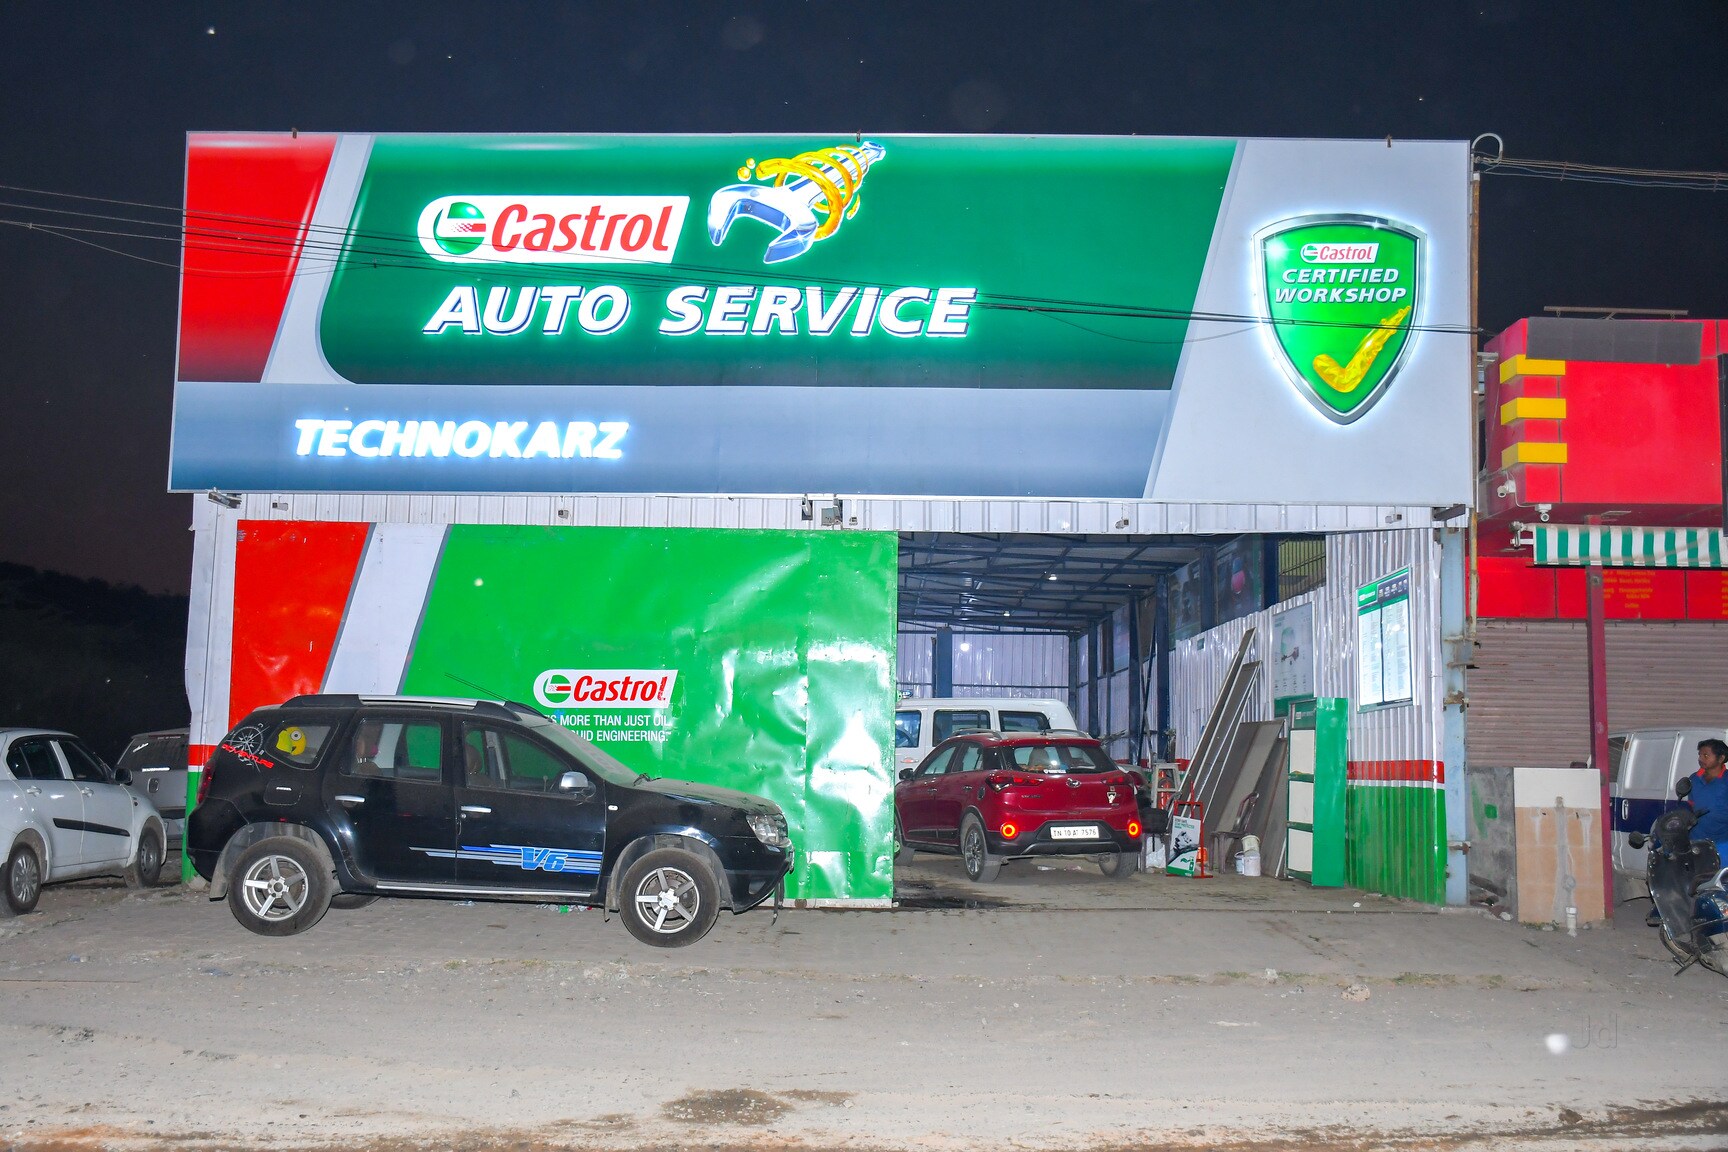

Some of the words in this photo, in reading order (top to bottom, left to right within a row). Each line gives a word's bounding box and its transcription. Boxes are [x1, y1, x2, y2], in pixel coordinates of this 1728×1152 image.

[491, 203, 673, 253] Castrol
[1319, 245, 1373, 261] Castrol
[1282, 268, 1399, 284] CERTIFIED
[1275, 288, 1407, 303] WORKSHOP
[422, 284, 632, 336] AUTO
[658, 285, 978, 338] SERVICE
[294, 418, 630, 459] TECHNOKARZ
[573, 675, 668, 702] Castrol
[560, 714, 591, 726] MORE
[593, 715, 622, 726] THAN
[624, 715, 651, 727] JUST
[520, 847, 569, 872] V6
